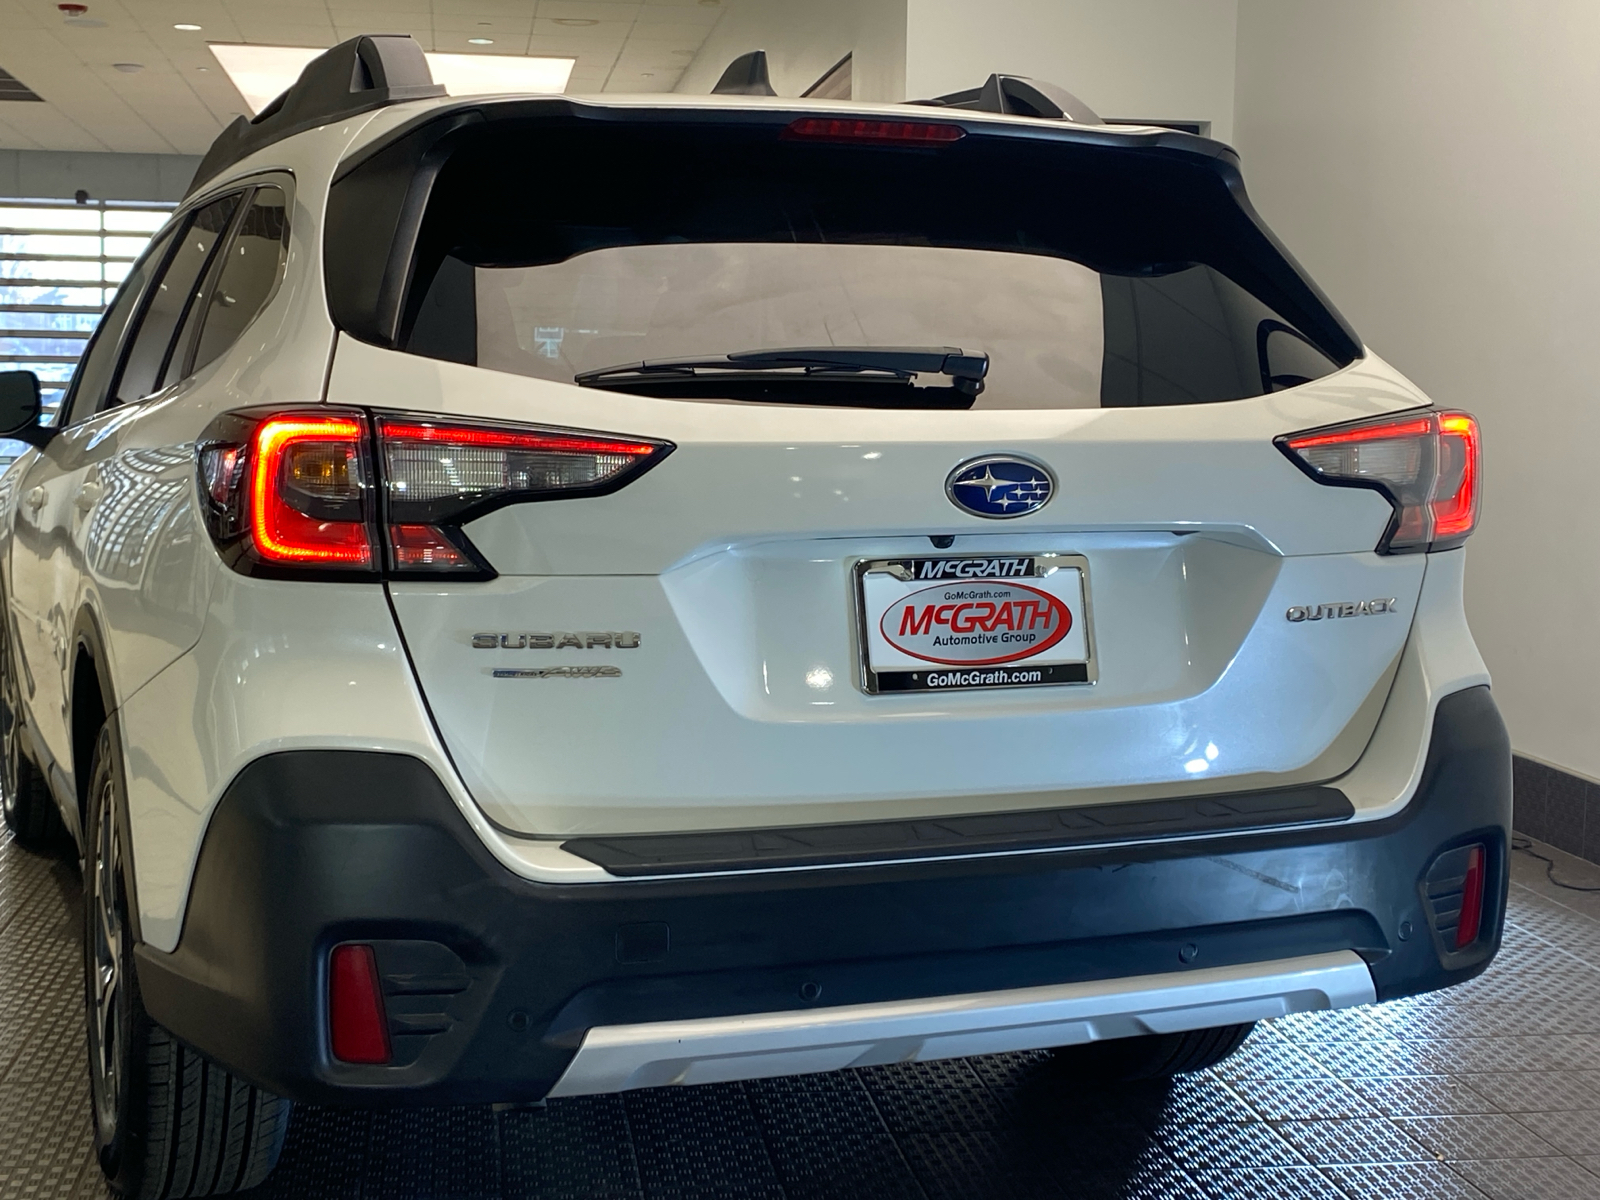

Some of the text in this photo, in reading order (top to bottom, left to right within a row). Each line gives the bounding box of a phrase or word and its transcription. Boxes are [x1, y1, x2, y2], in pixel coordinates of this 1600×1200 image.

[944, 590, 1011, 601] GoMcGrath.com
[1286, 597, 1397, 622] OUTBACK
[471, 632, 641, 649] SUBARU
[932, 632, 1036, 647] Automotive Group
[927, 669, 1041, 687] GoMcGrath.com
